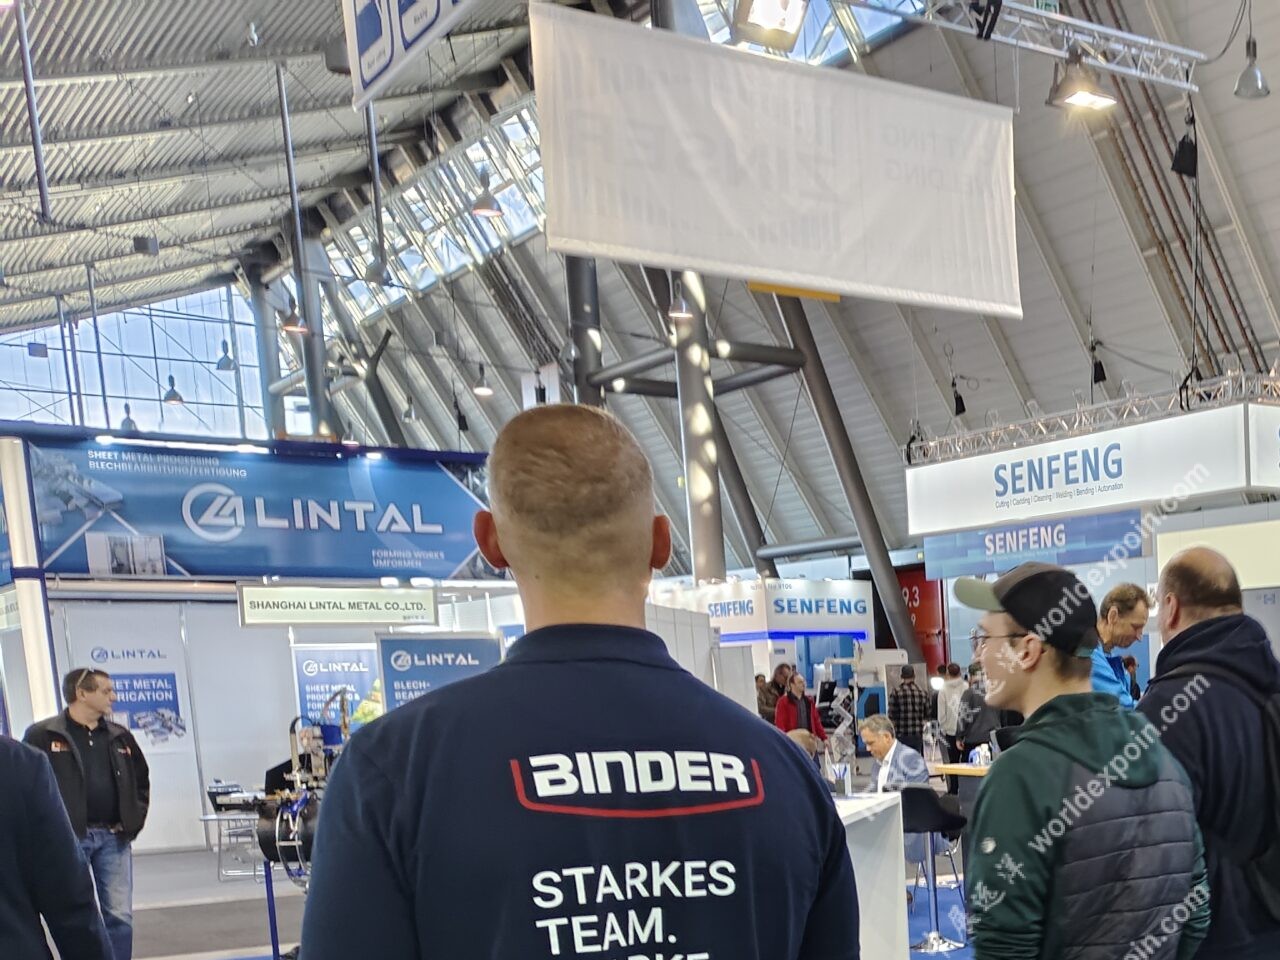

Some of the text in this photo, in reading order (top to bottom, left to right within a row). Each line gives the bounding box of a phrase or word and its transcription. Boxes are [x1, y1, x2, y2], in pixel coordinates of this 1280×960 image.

[88, 450, 118, 460] SHEET
[122, 452, 153, 463] METAL
[994, 443, 1123, 497] SENFENG
[995, 500, 1010, 509] Cutting
[1077, 487, 1095, 496] Bending
[1097, 482, 1124, 493] Automation
[255, 497, 443, 534] LINTAL
[984, 524, 1066, 556] SENFENG
[249, 600, 427, 612] SHANGHAI LINTAL METAL CO.,LTD.
[708, 600, 754, 618] SENFENG
[774, 598, 867, 614] SENFENG
[111, 650, 167, 659] LINTAL
[414, 652, 479, 666] LINTAL
[320, 662, 369, 672] LINTAL
[133, 679, 172, 690] METAL
[529, 751, 750, 798] BINDER
[532, 860, 737, 909] STARKES
[535, 907, 677, 955] TEAM.
